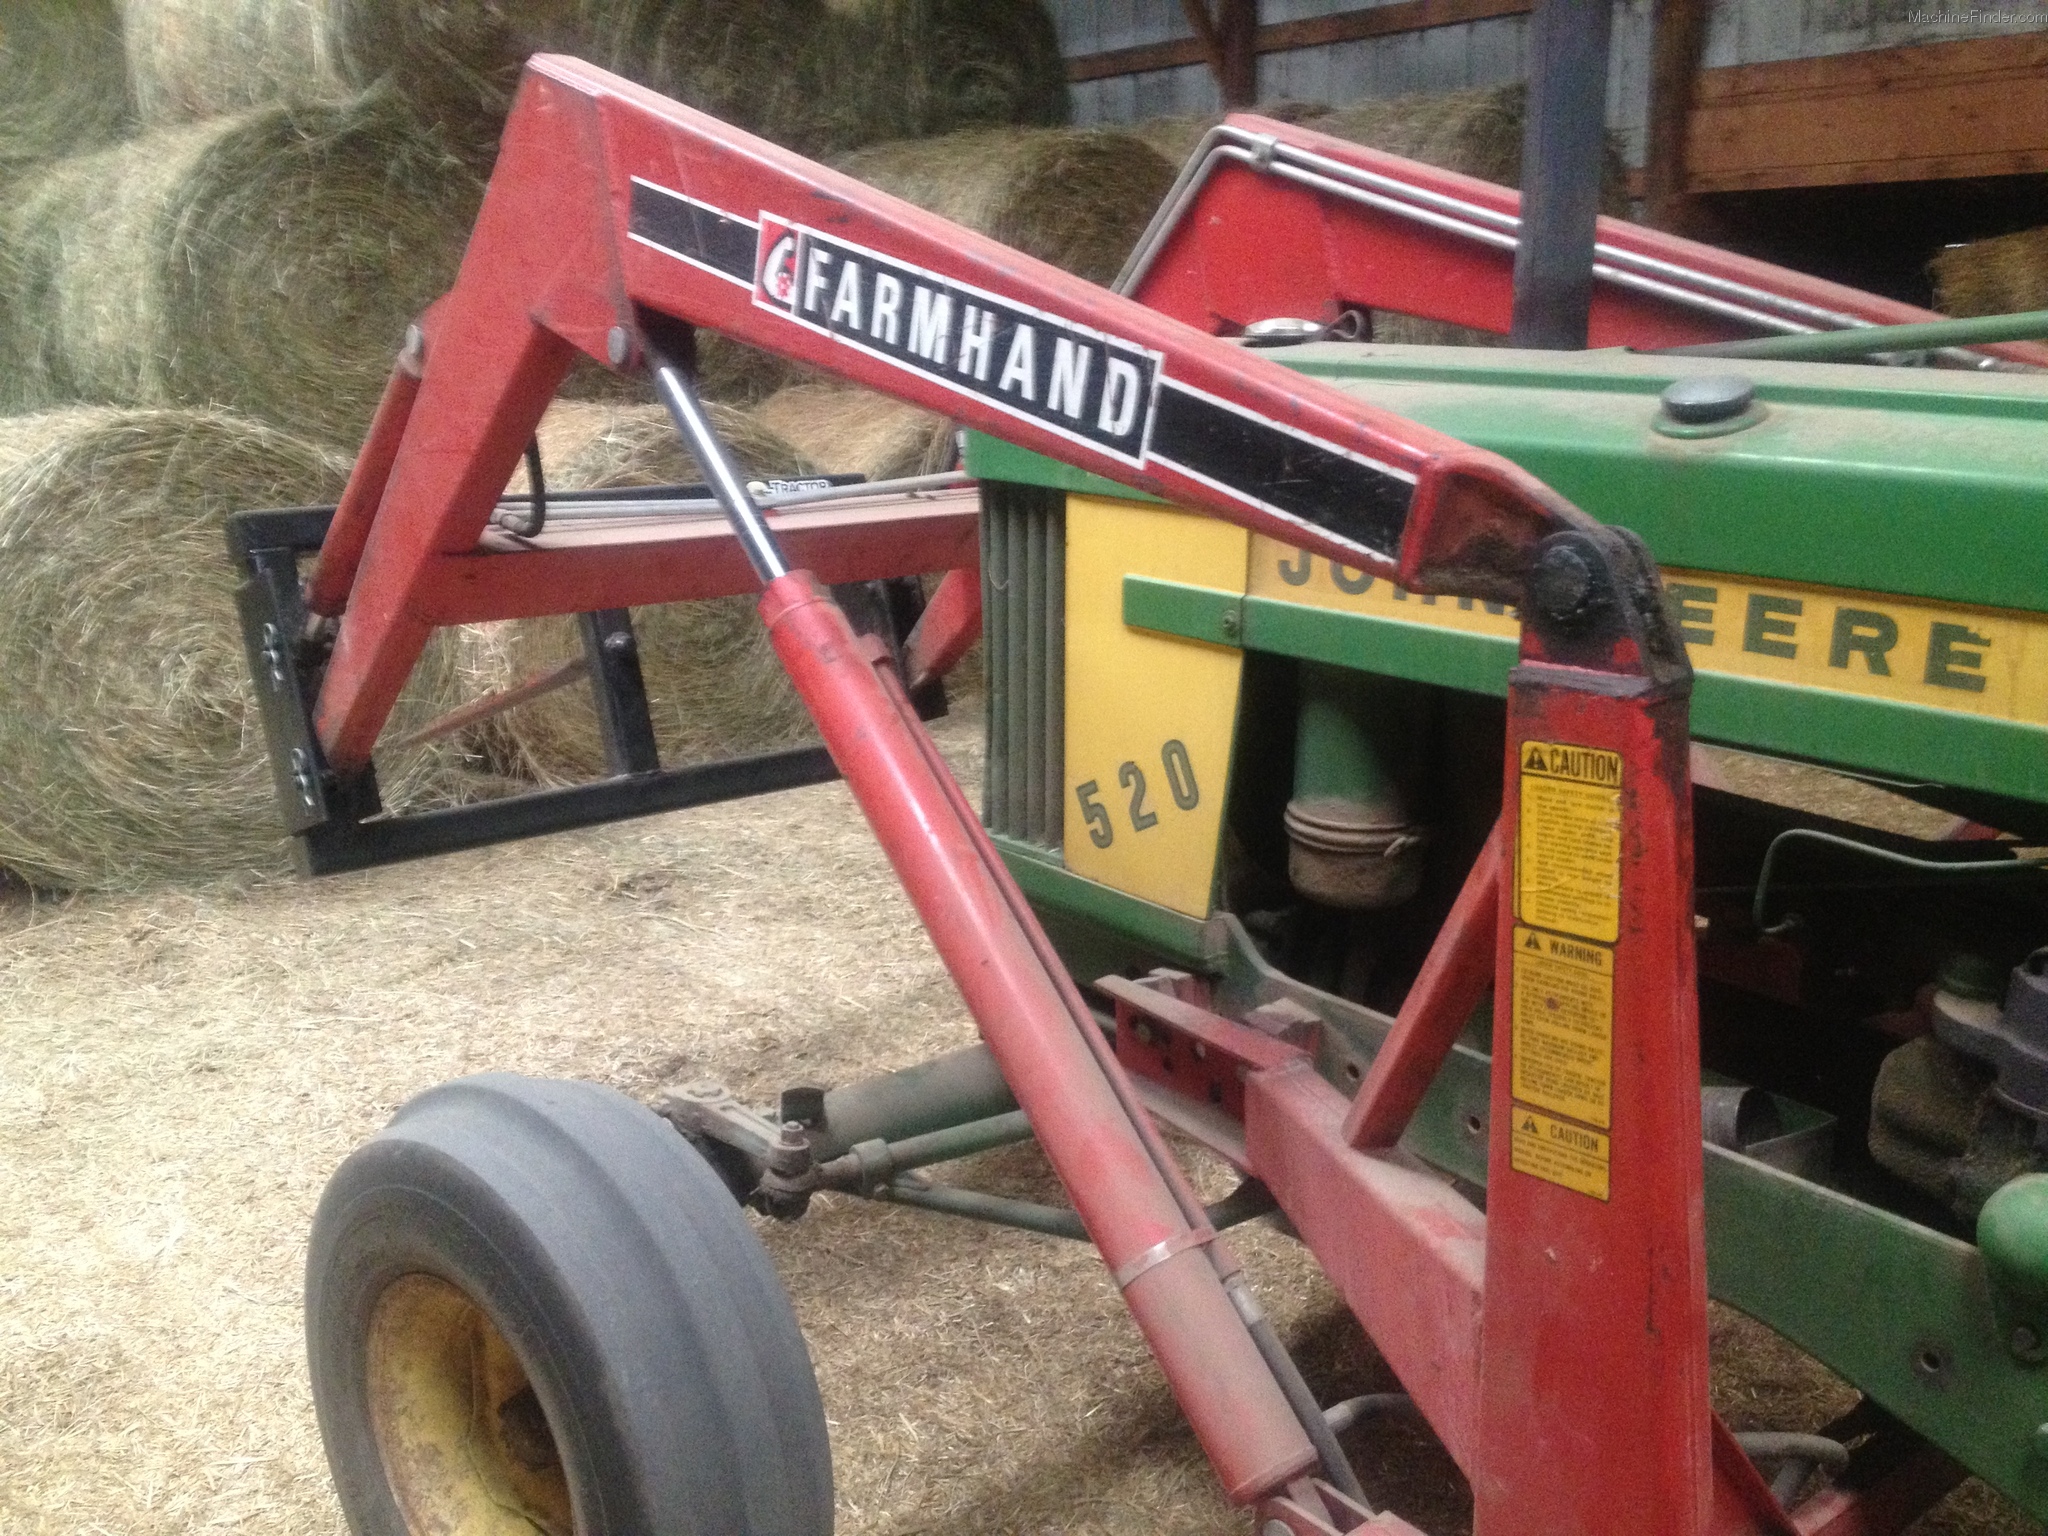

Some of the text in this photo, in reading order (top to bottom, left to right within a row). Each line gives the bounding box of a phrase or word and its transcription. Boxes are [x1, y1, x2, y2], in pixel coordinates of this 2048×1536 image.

[804, 246, 1142, 437] FARMHAND
[1278, 550, 1505, 615] JO
[1660, 582, 1992, 693] EERE
[1076, 739, 1199, 849] 520
[1550, 748, 1619, 782] CAUTION
[1550, 939, 1602, 967] WARNING
[1550, 1124, 1599, 1152] CAUTION
